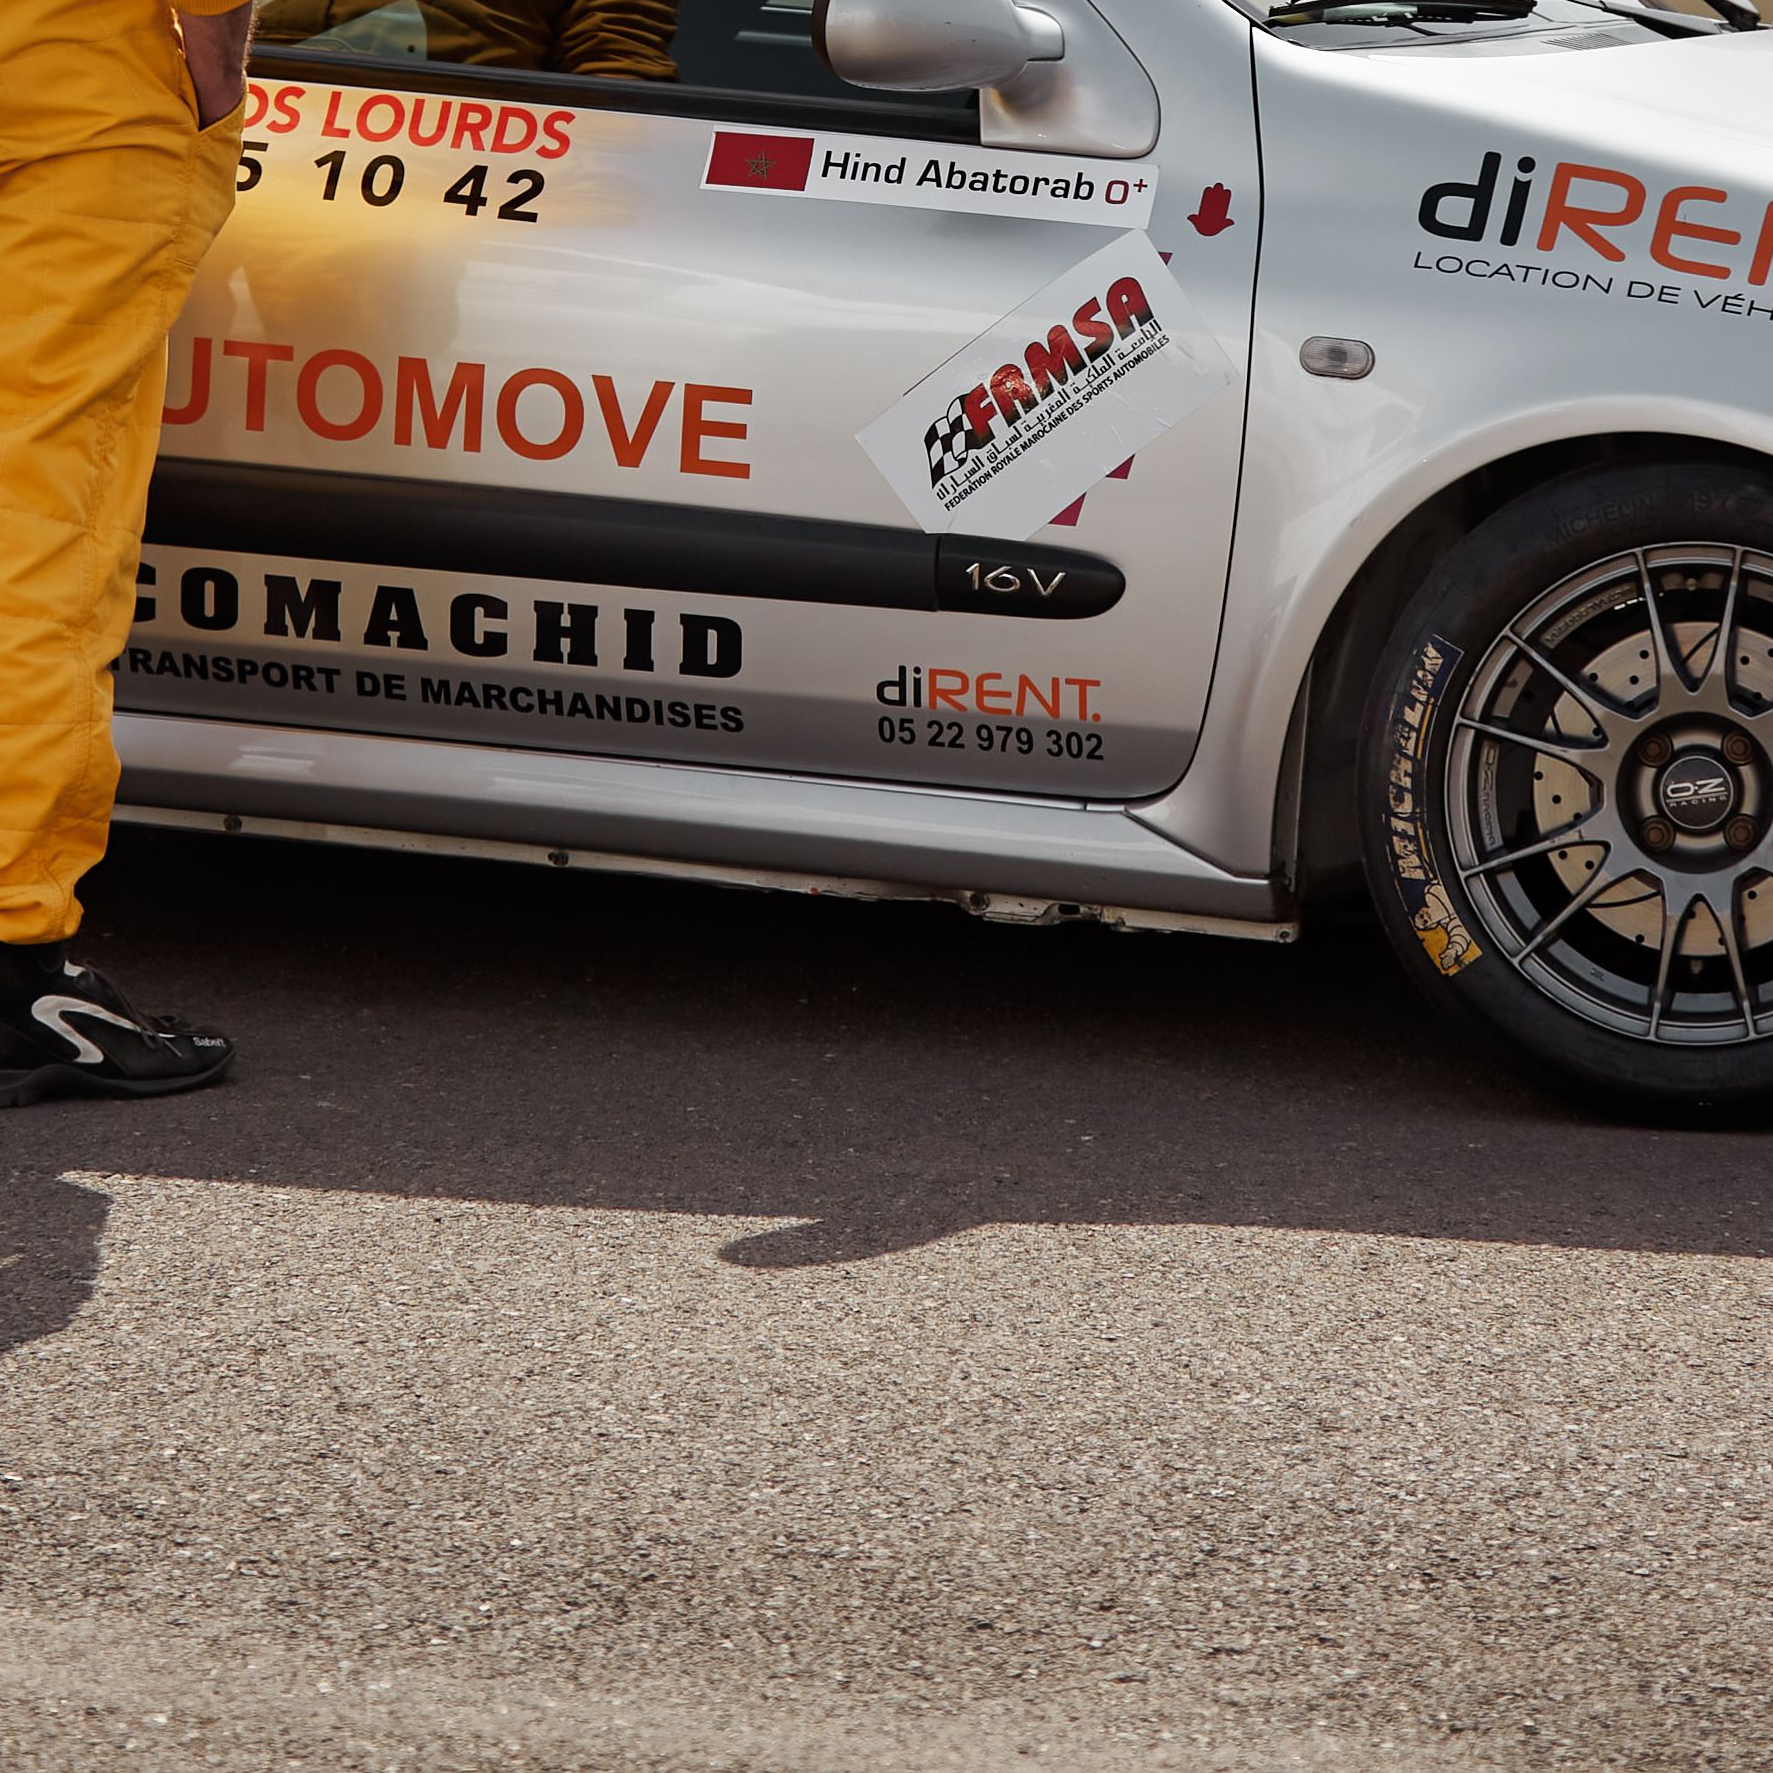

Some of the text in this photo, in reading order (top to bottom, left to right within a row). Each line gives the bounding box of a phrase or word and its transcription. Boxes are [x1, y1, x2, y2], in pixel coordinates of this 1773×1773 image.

[320, 90, 577, 160] LOURDS
[313, 148, 406, 208] 10
[442, 164, 546, 223] 42
[821, 149, 905, 185] Hind
[916, 159, 1096, 202] Abatorab
[1413, 251, 1614, 295] LOCATION
[1626, 279, 1680, 306] DE
[991, 449, 1022, 476] ROYALE
[1019, 410, 1069, 453] MAROCAINE
[1066, 397, 1085, 417] DES
[1082, 377, 1115, 405] SPORTS
[1113, 334, 1171, 384] AUTOMOBILES
[354, 671, 407, 702] DE
[419, 675, 745, 734] MARCHANDISES
[877, 715, 1105, 762] 05 22 979 302
